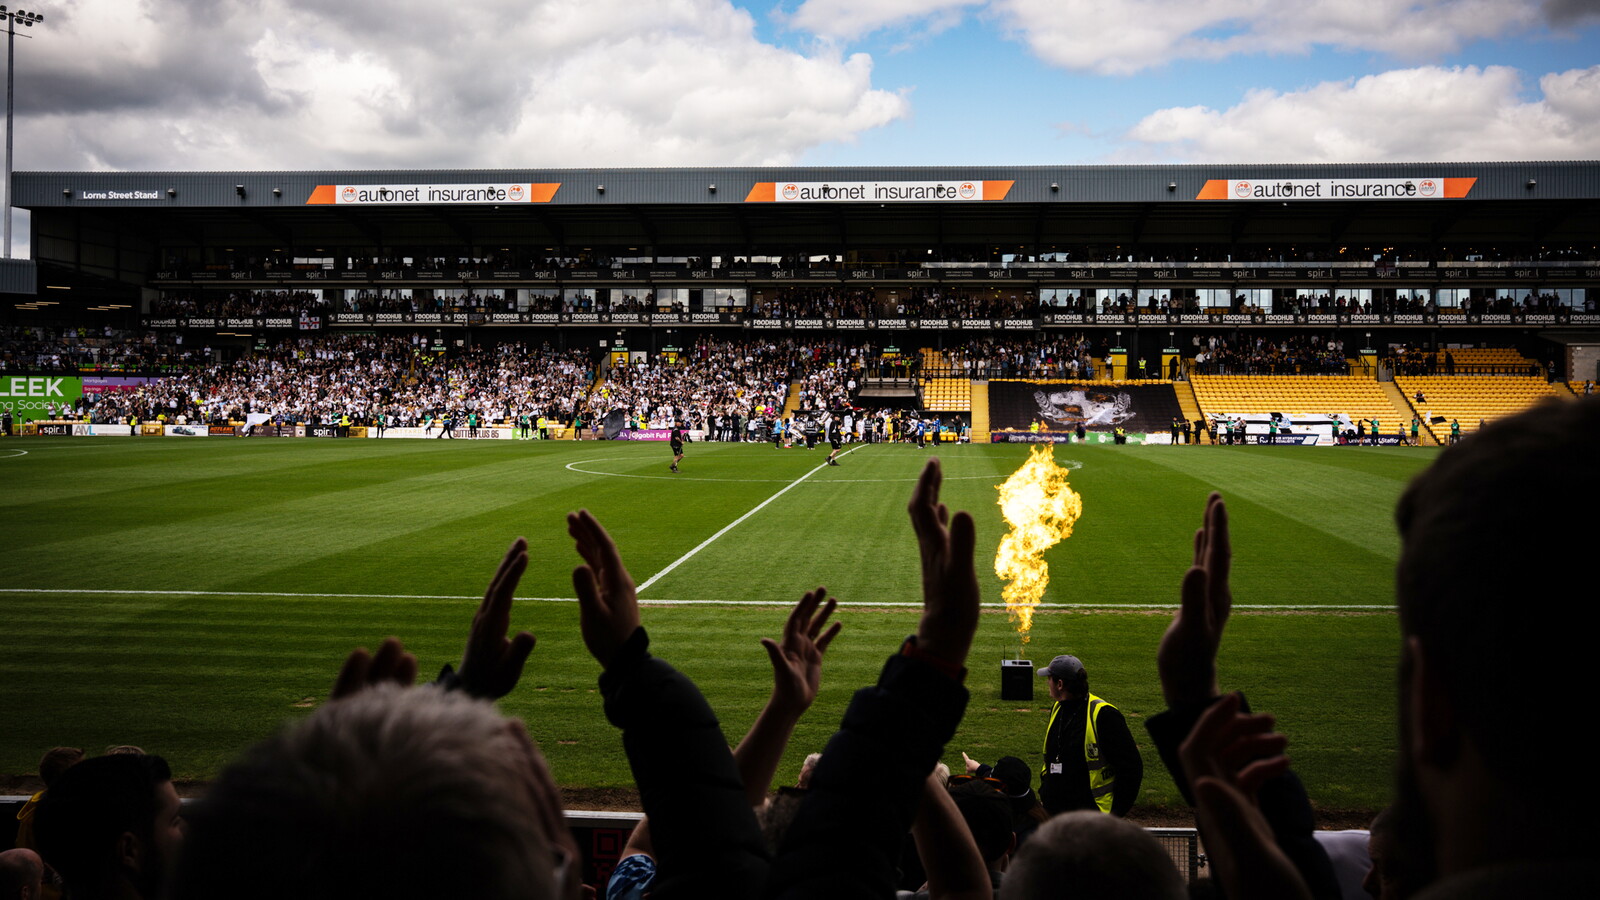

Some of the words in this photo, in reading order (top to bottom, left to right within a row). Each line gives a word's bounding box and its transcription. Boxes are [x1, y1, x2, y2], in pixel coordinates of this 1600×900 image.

[83, 191, 106, 199] Lorne
[108, 191, 132, 199] Street
[134, 191, 158, 199] Stand
[358, 188, 420, 202] autonet
[428, 186, 506, 202] insurance
[800, 185, 865, 200] autonet
[874, 184, 957, 199] insurance
[1254, 182, 1321, 198] autonet
[1330, 181, 1417, 197] insurance
[18, 399, 63, 412] Society
[74, 426, 96, 435] AML
